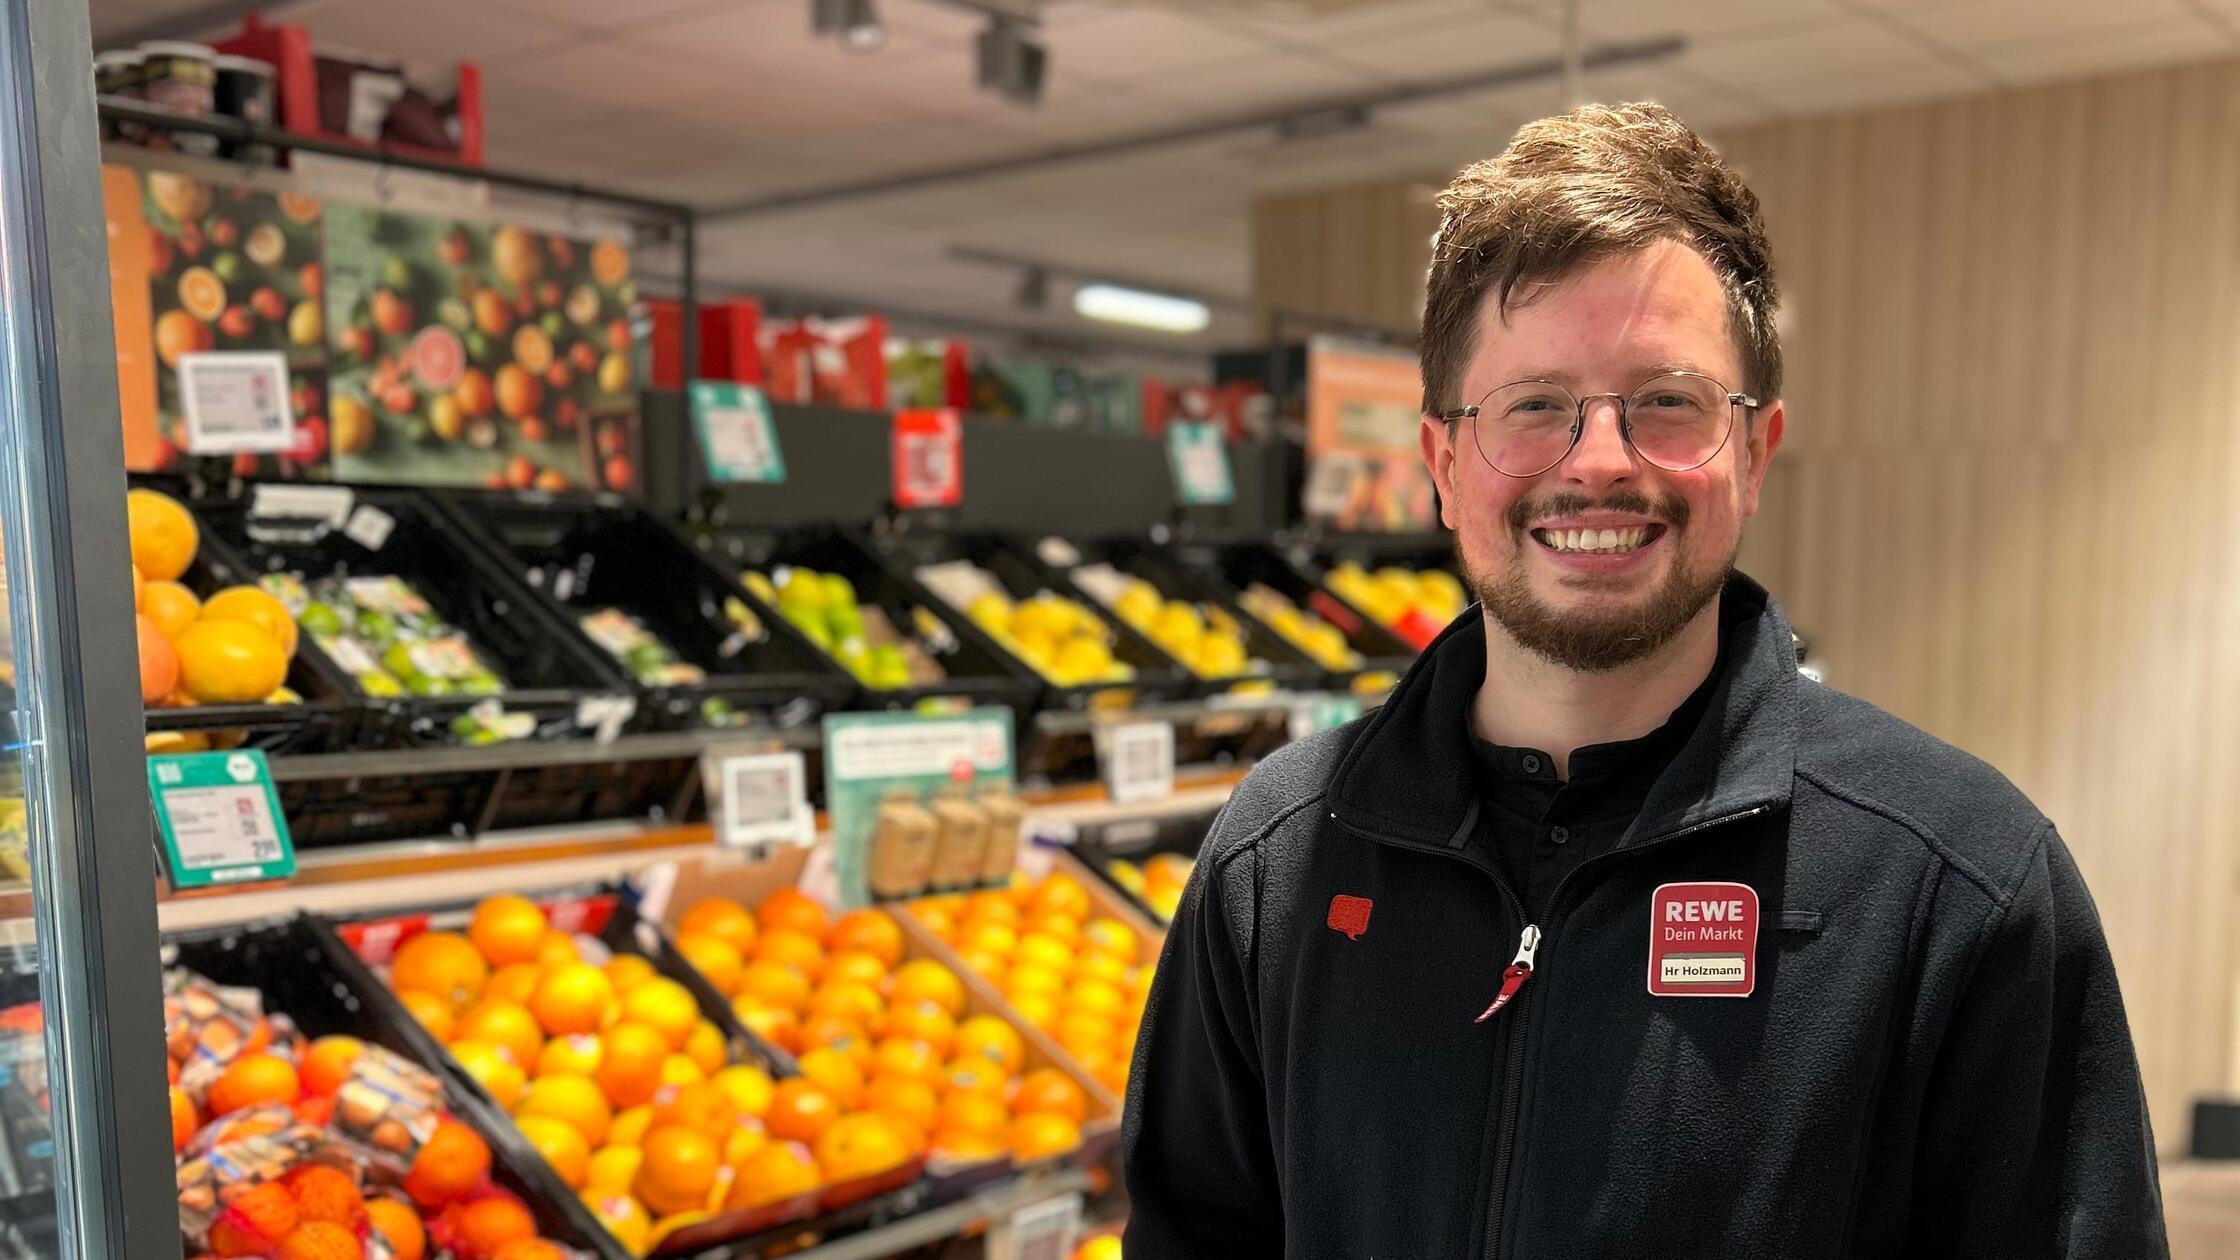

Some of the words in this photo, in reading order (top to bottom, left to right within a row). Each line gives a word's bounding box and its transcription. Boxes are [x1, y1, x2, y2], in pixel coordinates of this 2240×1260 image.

[1665, 900, 1744, 922] REWE
[1665, 927, 1696, 941] Dein
[1699, 926, 1744, 941] Markt
[1665, 966, 1680, 976] Hr
[1682, 966, 1742, 976] Holzmann
